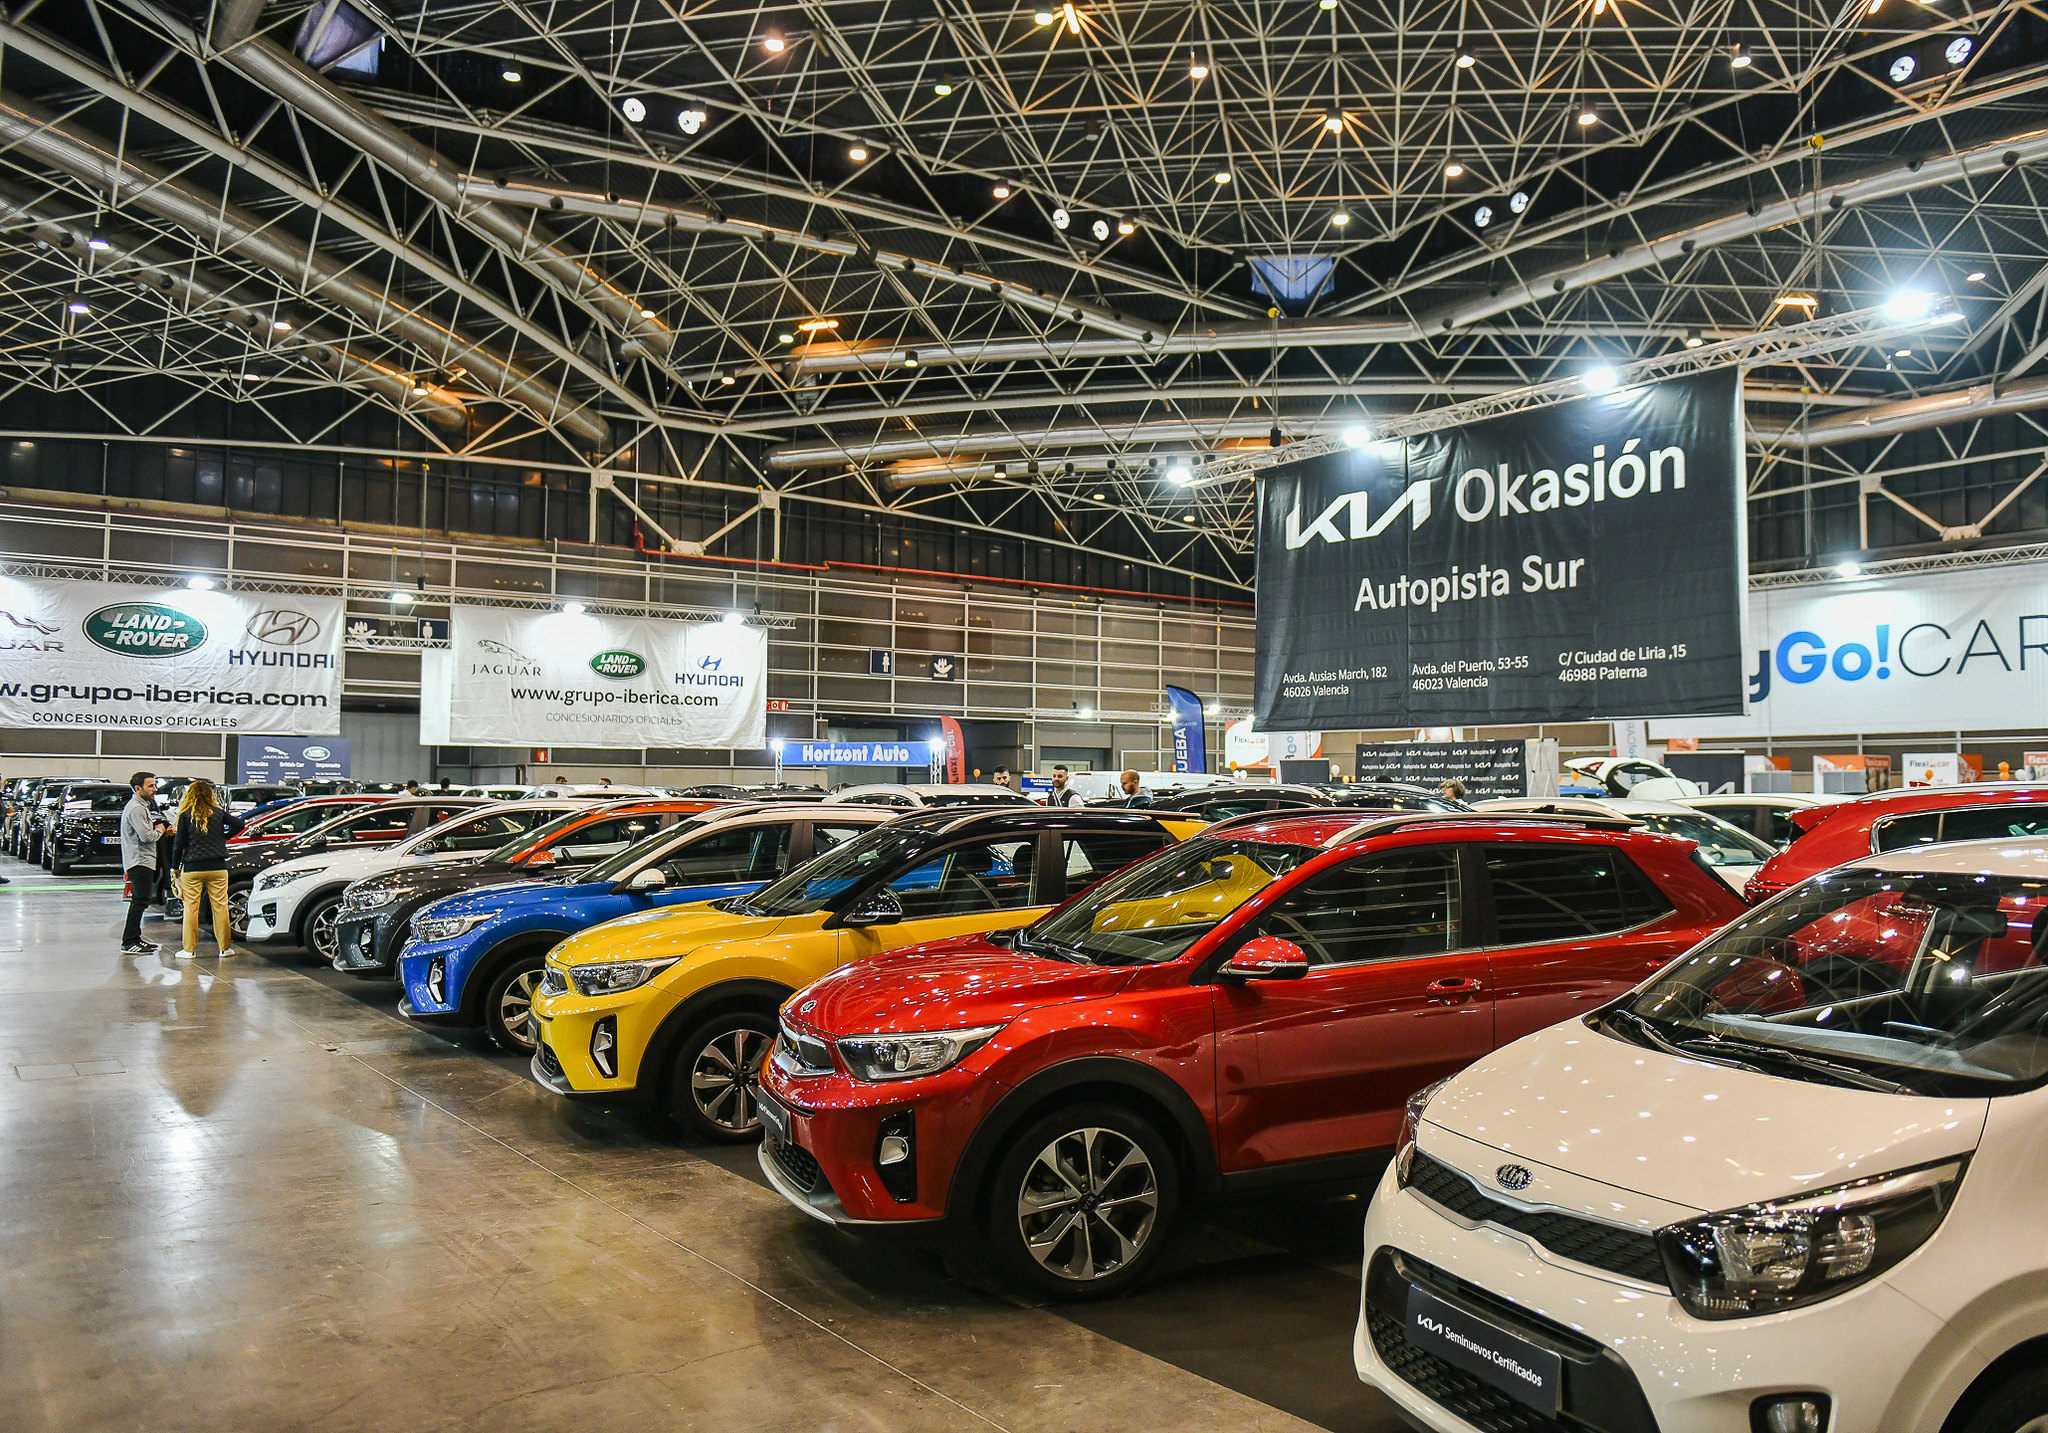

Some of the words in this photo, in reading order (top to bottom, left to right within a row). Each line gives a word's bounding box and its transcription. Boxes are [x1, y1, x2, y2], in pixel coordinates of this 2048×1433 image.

[1286, 479, 1431, 551] KIA
[1454, 438, 1686, 523] Okasión
[1354, 563, 1510, 613] Autopista
[1522, 555, 1585, 593] Sur
[112, 613, 172, 631] LAND
[116, 630, 189, 649] ROVER
[229, 650, 335, 669] HYUNDAI
[600, 654, 631, 665] LAND
[1558, 652, 1573, 666] C/
[1574, 649, 1617, 665] Ciudad
[1620, 648, 1636, 661] de
[1638, 646, 1666, 660] Liria
[472, 663, 542, 677] JAGUAR
[604, 663, 639, 674] ROVER
[1412, 663, 1440, 676] Avda.
[1441, 661, 1456, 674] del
[1458, 658, 1496, 673] Puerto,
[1498, 655, 1529, 670] 53-55
[1558, 667, 1597, 682] 46988
[1599, 666, 1648, 680] Paterna
[675, 672, 744, 688] HYUNDAI
[1283, 673, 1307, 684] Avda.
[1309, 671, 1337, 683] Ausias
[1338, 668, 1369, 682] March,
[1370, 666, 1388, 678] 182
[1412, 678, 1444, 691] 46023
[1445, 675, 1489, 689] Valencia
[511, 688, 719, 707] www.grupo-iberica.com
[1283, 686, 1312, 698] 46026
[1312, 684, 1349, 697] Valencia
[32, 712, 162, 726] CONCESIONARIOS
[166, 716, 238, 728] OFICIALES
[546, 712, 635, 724] CONCESIONARIOS
[636, 715, 683, 725] OFICIALES
[802, 743, 869, 762] Horizont
[872, 744, 910, 762] Auto
[105, 837, 121, 845] 9280
[1498, 1165, 1529, 1187] KIA
[1445, 1326, 1492, 1361] Seminuevos
[1492, 1351, 1543, 1388] Certificados
